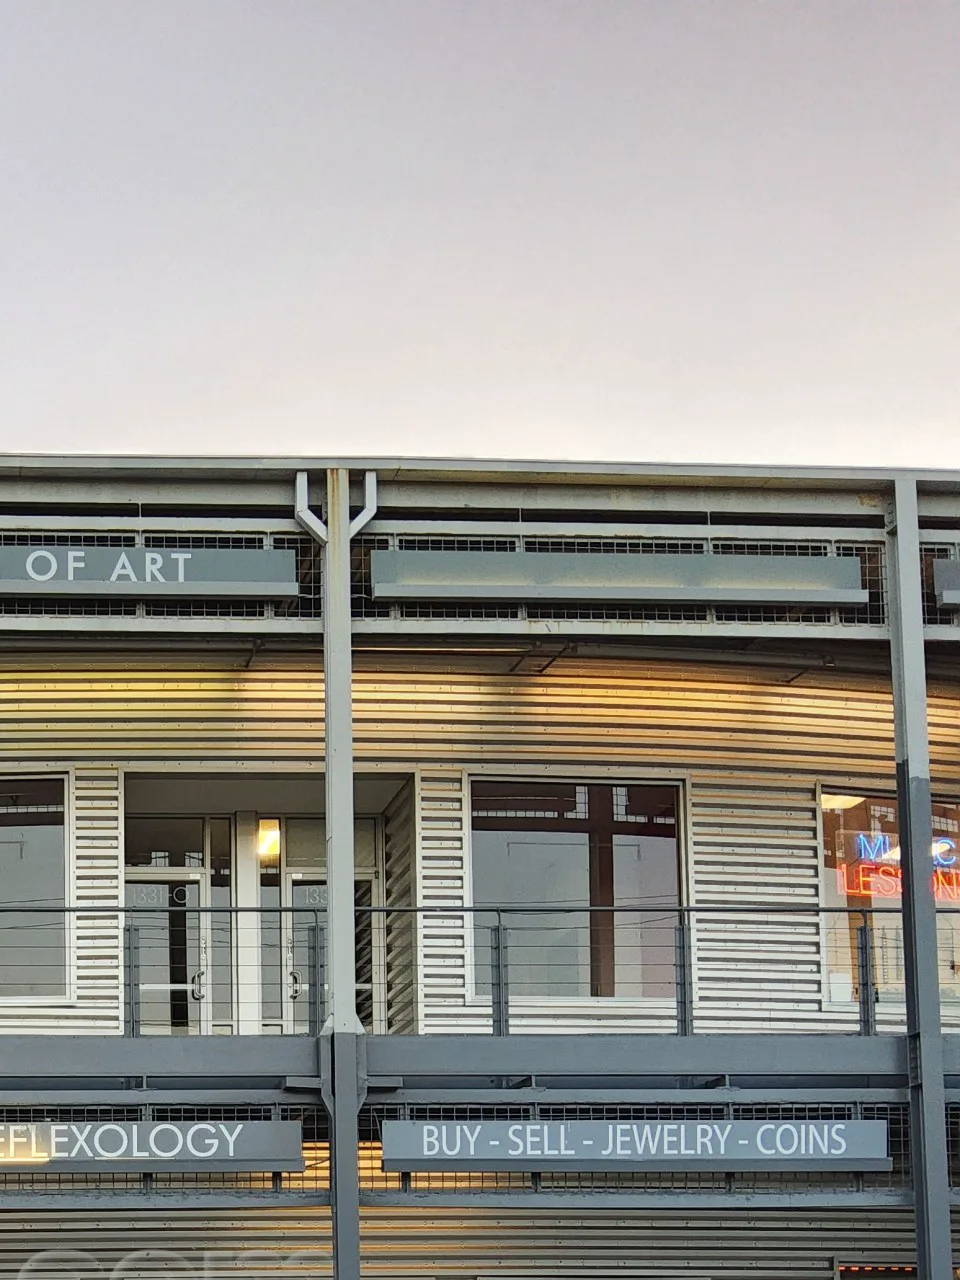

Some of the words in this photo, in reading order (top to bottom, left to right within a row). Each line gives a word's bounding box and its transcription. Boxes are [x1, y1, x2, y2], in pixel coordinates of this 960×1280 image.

[25, 551, 86, 581] OF
[110, 552, 192, 582] ART
[422, 1124, 481, 1156] BUY
[507, 1124, 575, 1155] SELL
[600, 1123, 732, 1156] JEWELRY
[756, 1123, 847, 1155] COINS
